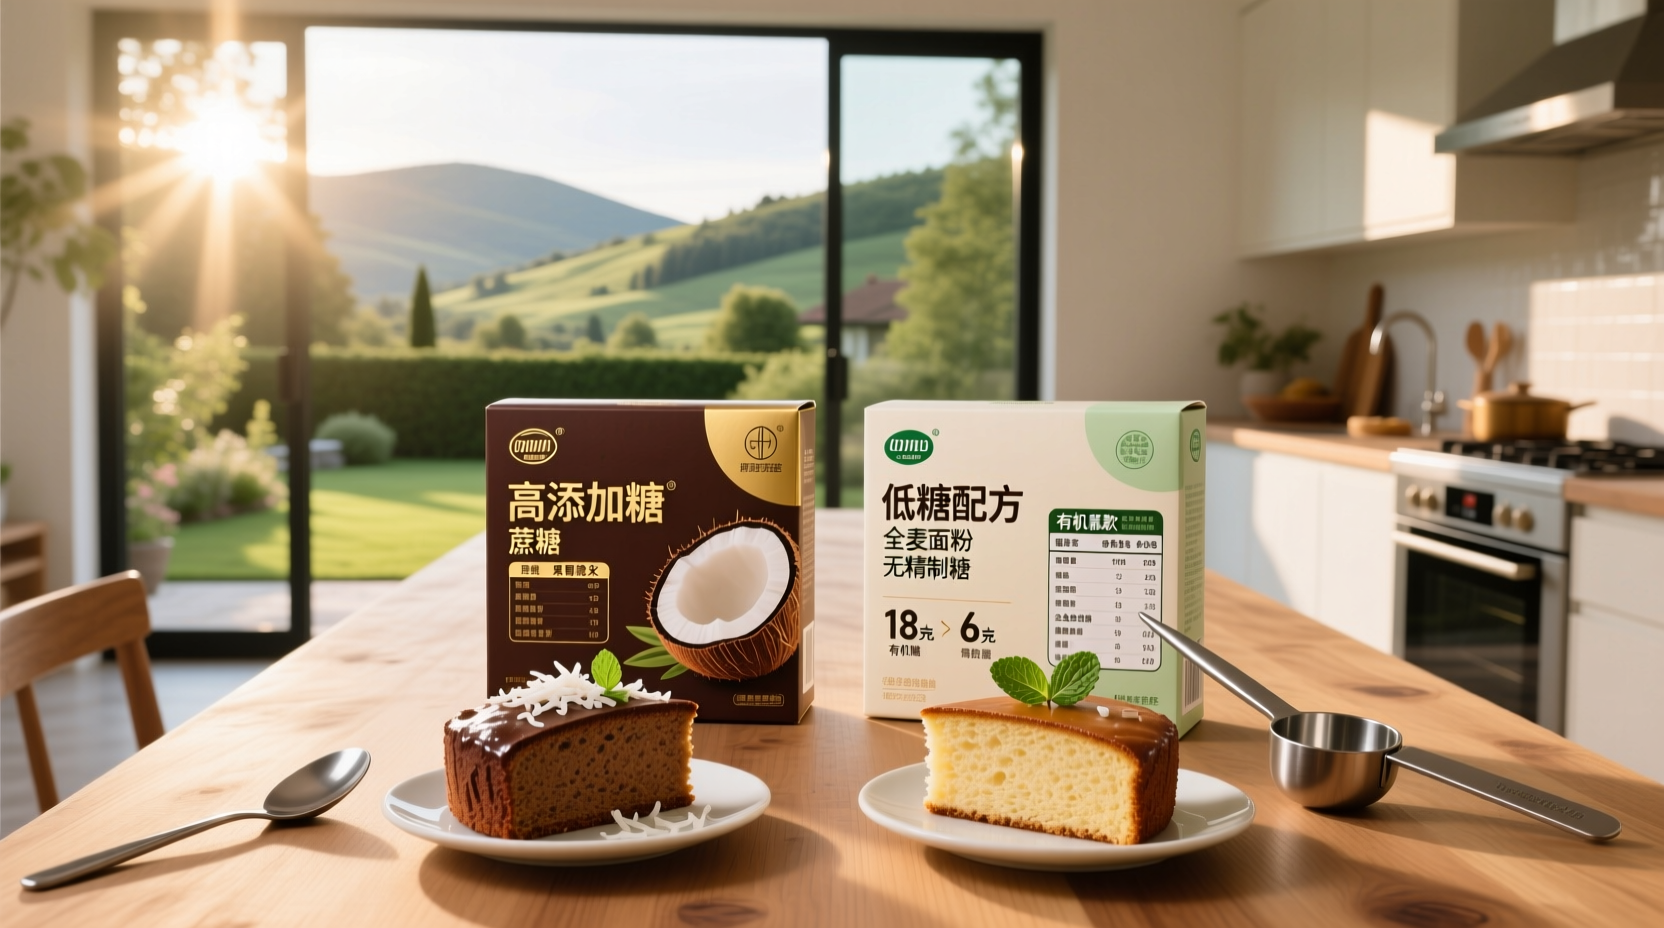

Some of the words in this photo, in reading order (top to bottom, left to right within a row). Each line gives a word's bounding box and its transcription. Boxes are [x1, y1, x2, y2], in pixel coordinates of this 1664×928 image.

[508, 481, 665, 523] 高添加糖
[882, 483, 1023, 523] 低糖配方
[508, 527, 561, 555] 蔗糖
[883, 526, 973, 552] 全麦面粉
[883, 555, 971, 580] 无精制糖
